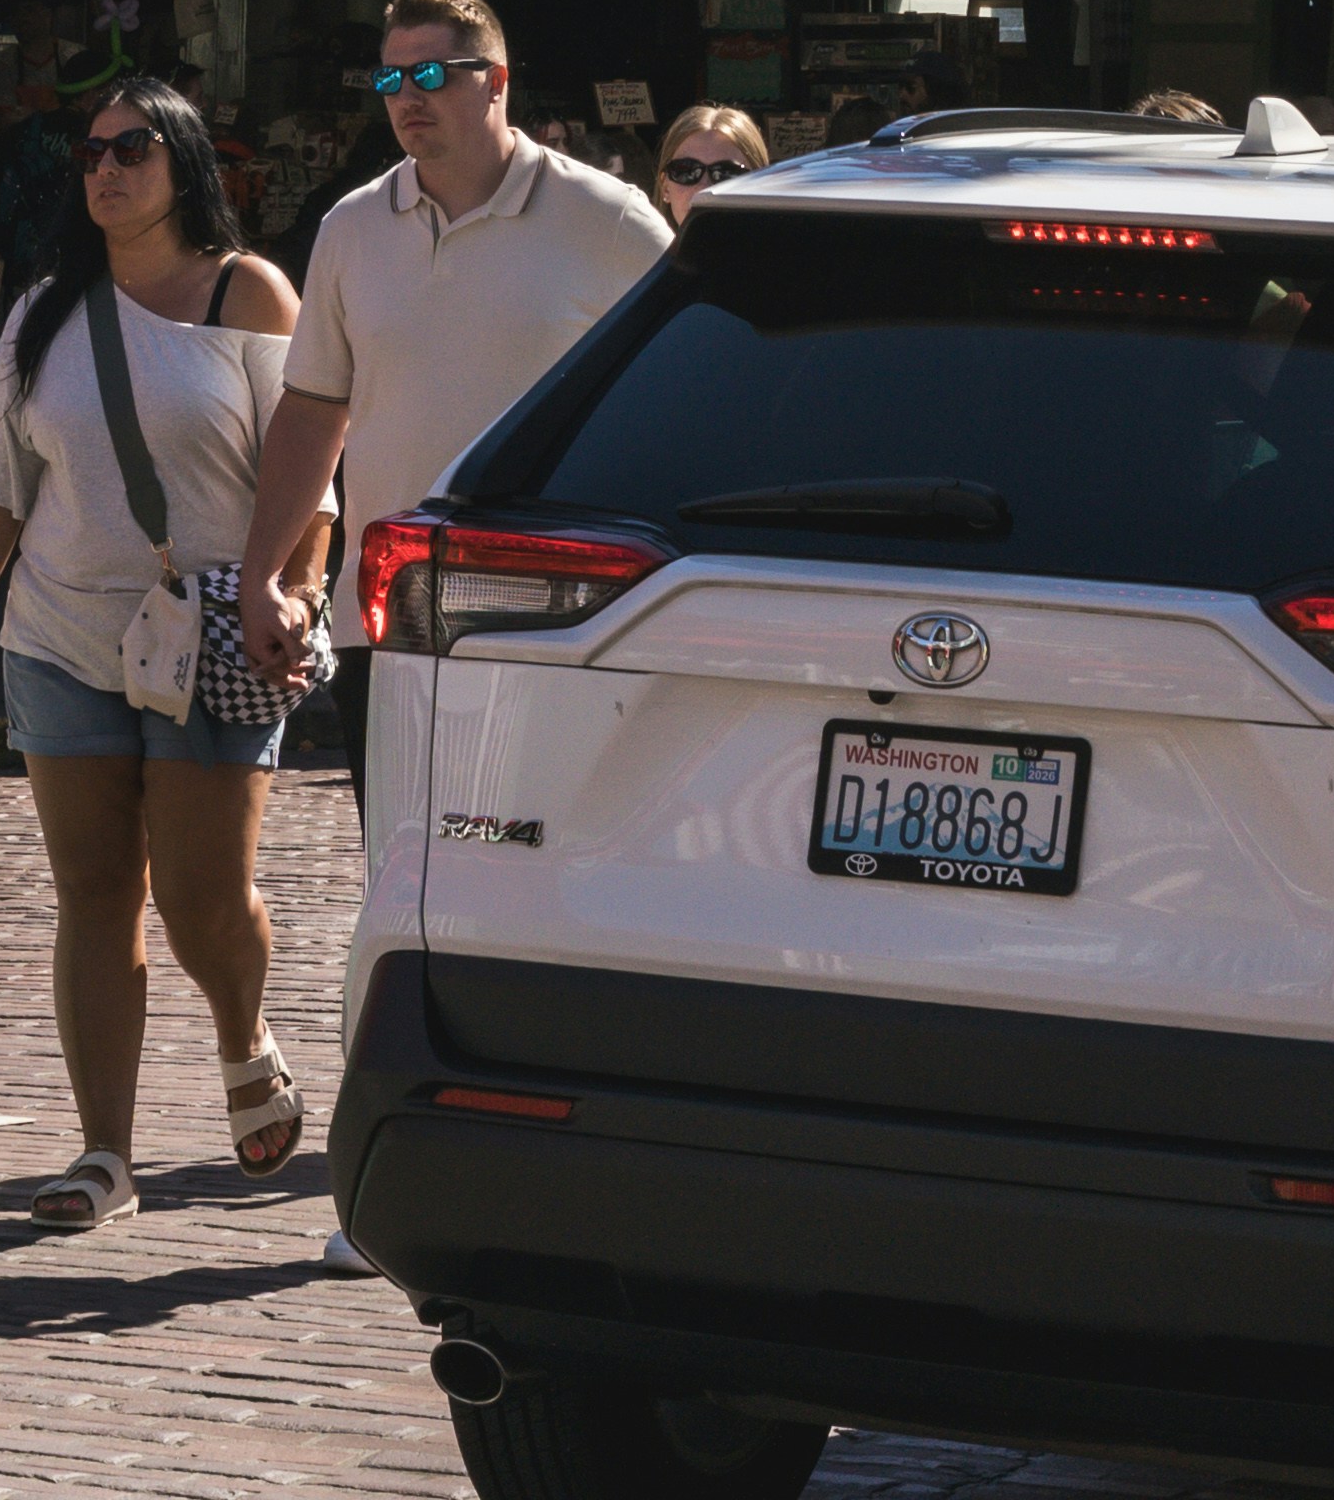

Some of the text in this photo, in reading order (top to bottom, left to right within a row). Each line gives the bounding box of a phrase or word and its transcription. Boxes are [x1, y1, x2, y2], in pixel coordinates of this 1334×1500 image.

[845, 744, 1018, 775] WASHINGTON 10
[1028, 770, 1056, 781] 2026
[437, 812, 544, 848] RAV4
[834, 775, 1062, 863] D18868J
[920, 860, 1024, 887] TOYOTA
